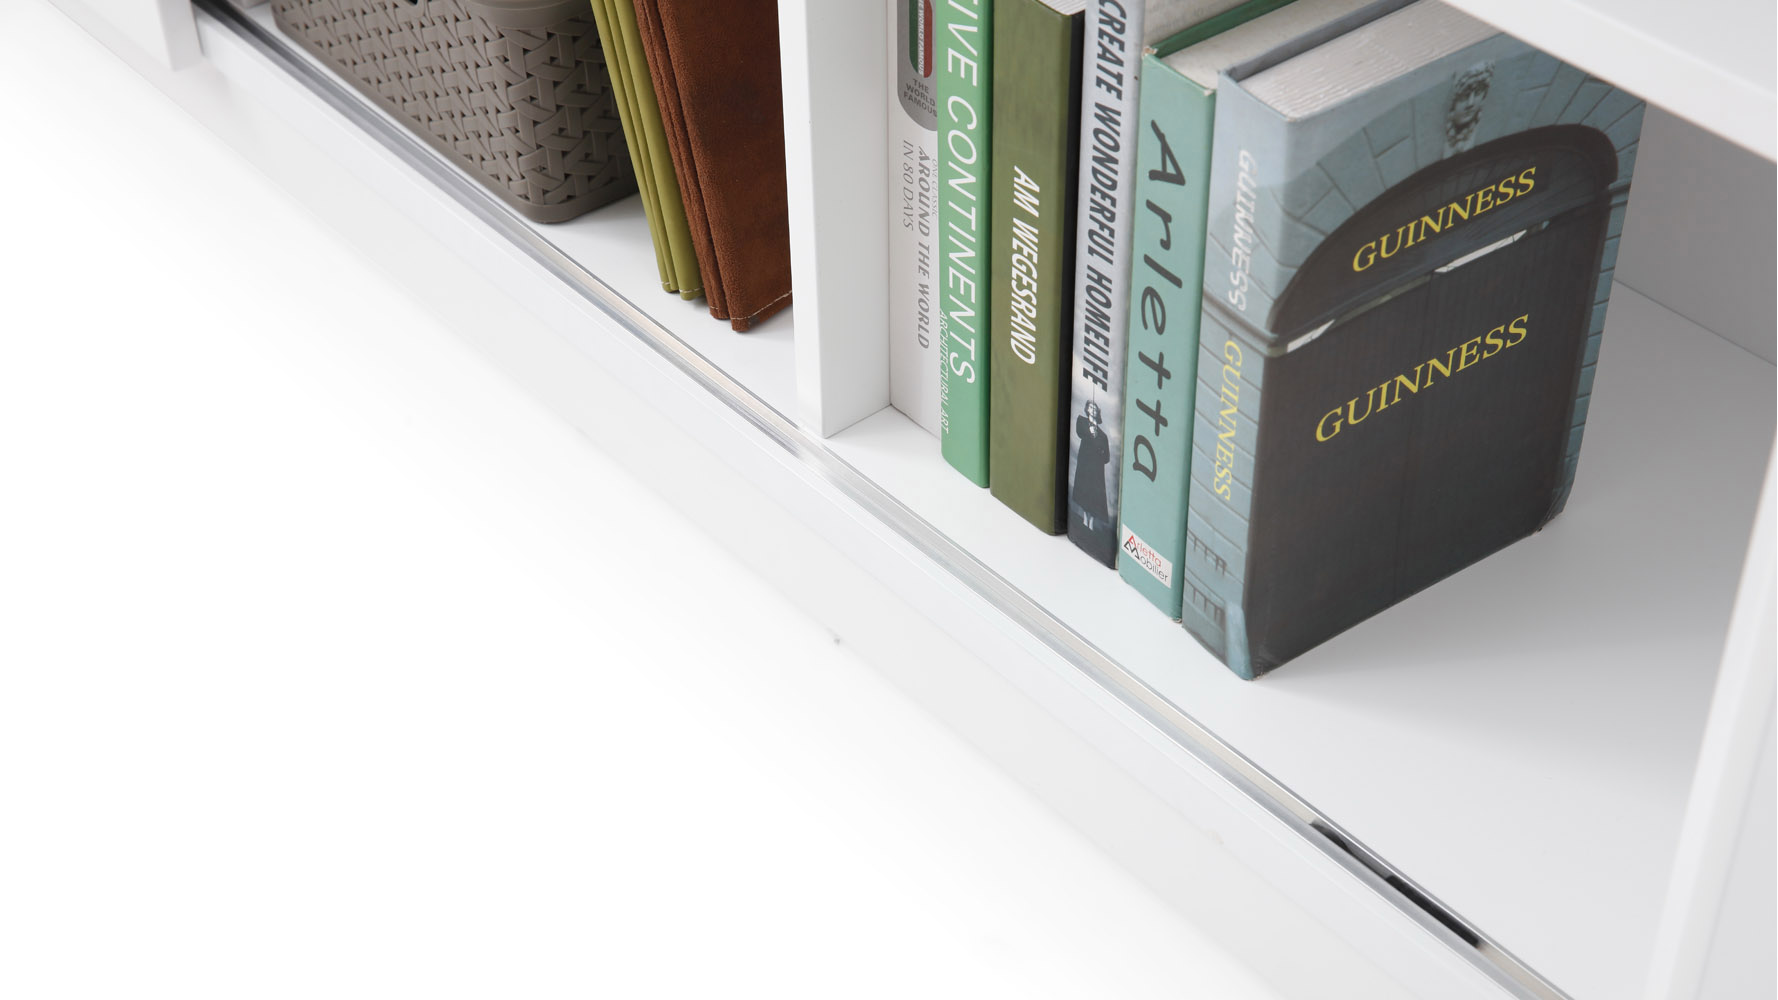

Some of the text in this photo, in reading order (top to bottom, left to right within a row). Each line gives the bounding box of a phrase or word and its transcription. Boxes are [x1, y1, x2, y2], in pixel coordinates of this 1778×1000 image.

[903, 90, 938, 118] FAMOUS
[905, 82, 936, 107] WORLD
[912, 78, 930, 95] THE
[903, 139, 914, 232] IN 80 DAYS
[917, 145, 931, 349] AROUND THE WORLD
[947, 0, 978, 384] IVE CONTINENTS
[1082, 0, 1128, 393] CREATE WONDERFUL HOMELIFE
[1228, 149, 1257, 312] GUINNESS
[1352, 166, 1537, 272] GUINNESS
[1010, 165, 1040, 365] AM WEGESRAND
[1132, 119, 1186, 483] Arletta
[940, 307, 949, 434] ARCHITECTURAL ART
[1213, 339, 1243, 501] GUINNESS
[1315, 314, 1529, 442] GUINNESS
[1123, 541, 1169, 582] Mobilier
[1128, 535, 1162, 568] Arletta
